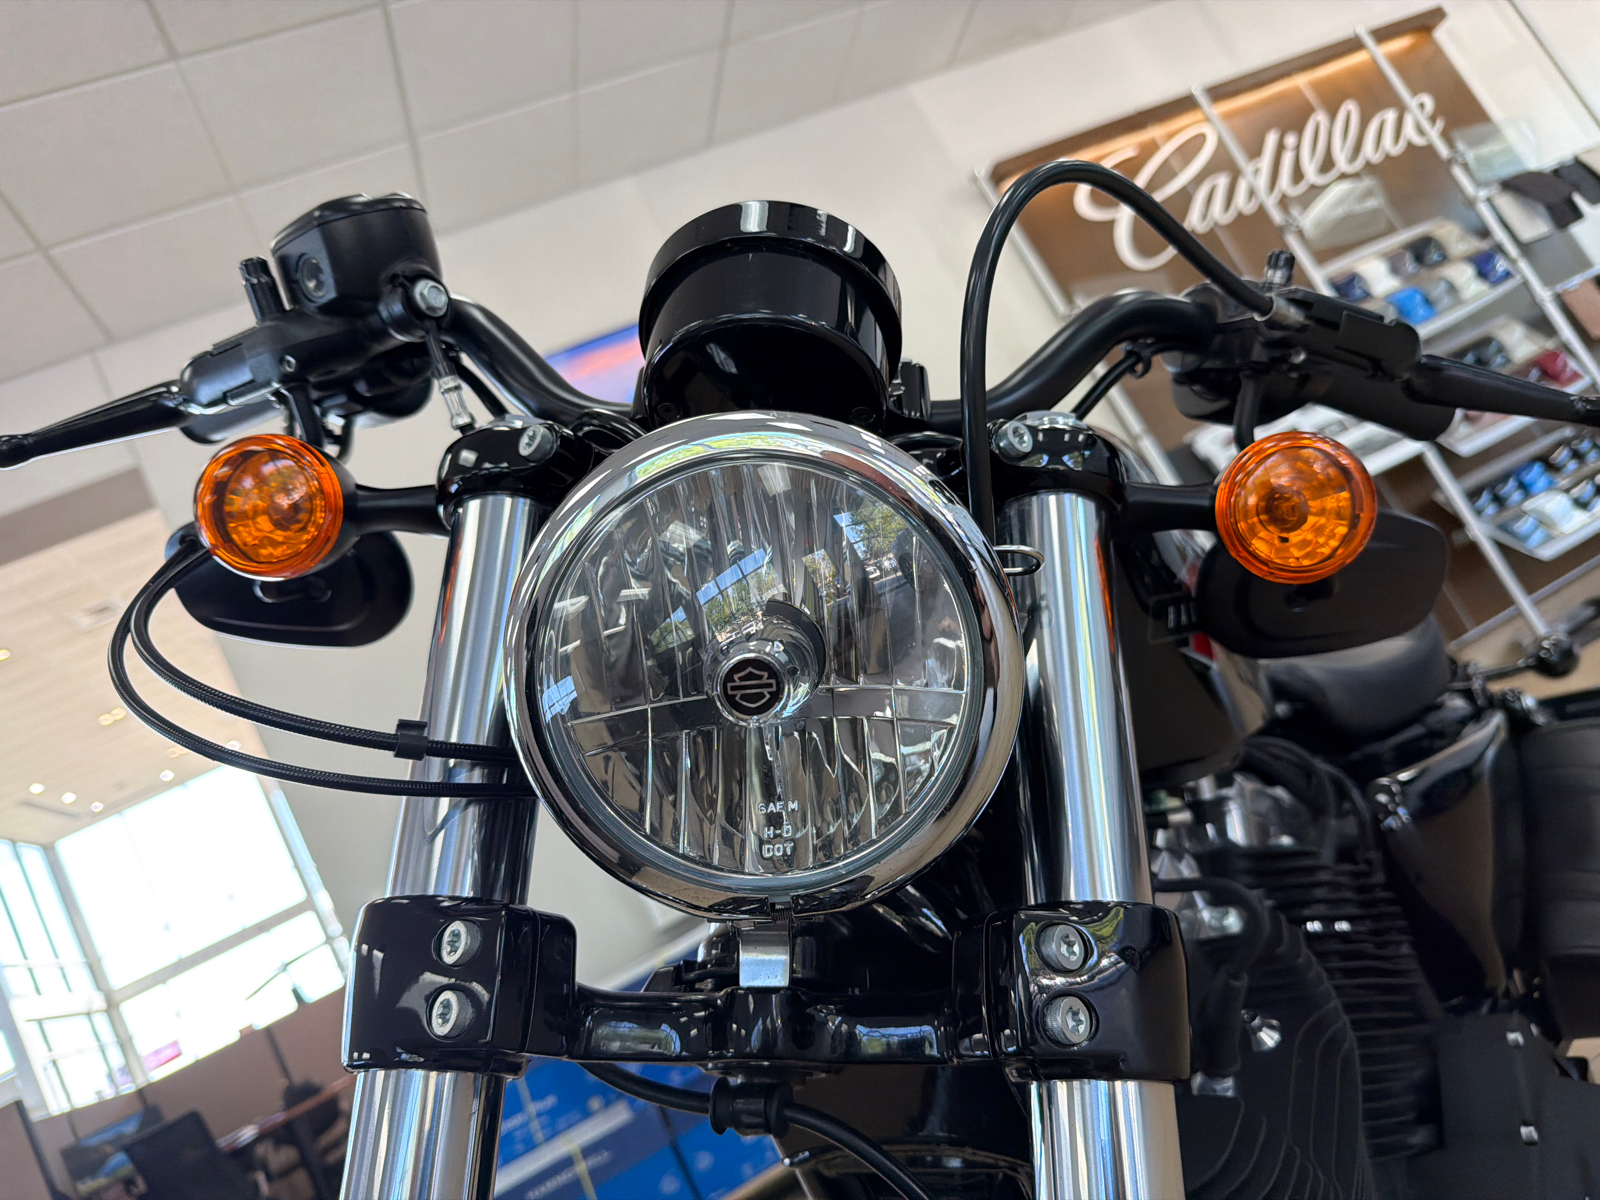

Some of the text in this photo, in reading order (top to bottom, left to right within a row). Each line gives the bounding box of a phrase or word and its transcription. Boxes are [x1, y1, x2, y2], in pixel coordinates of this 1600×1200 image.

[1073, 92, 1445, 272] Cadillac
[758, 800, 799, 814] SAE M
[763, 825, 793, 838] H-D
[762, 842, 794, 858] DOT
